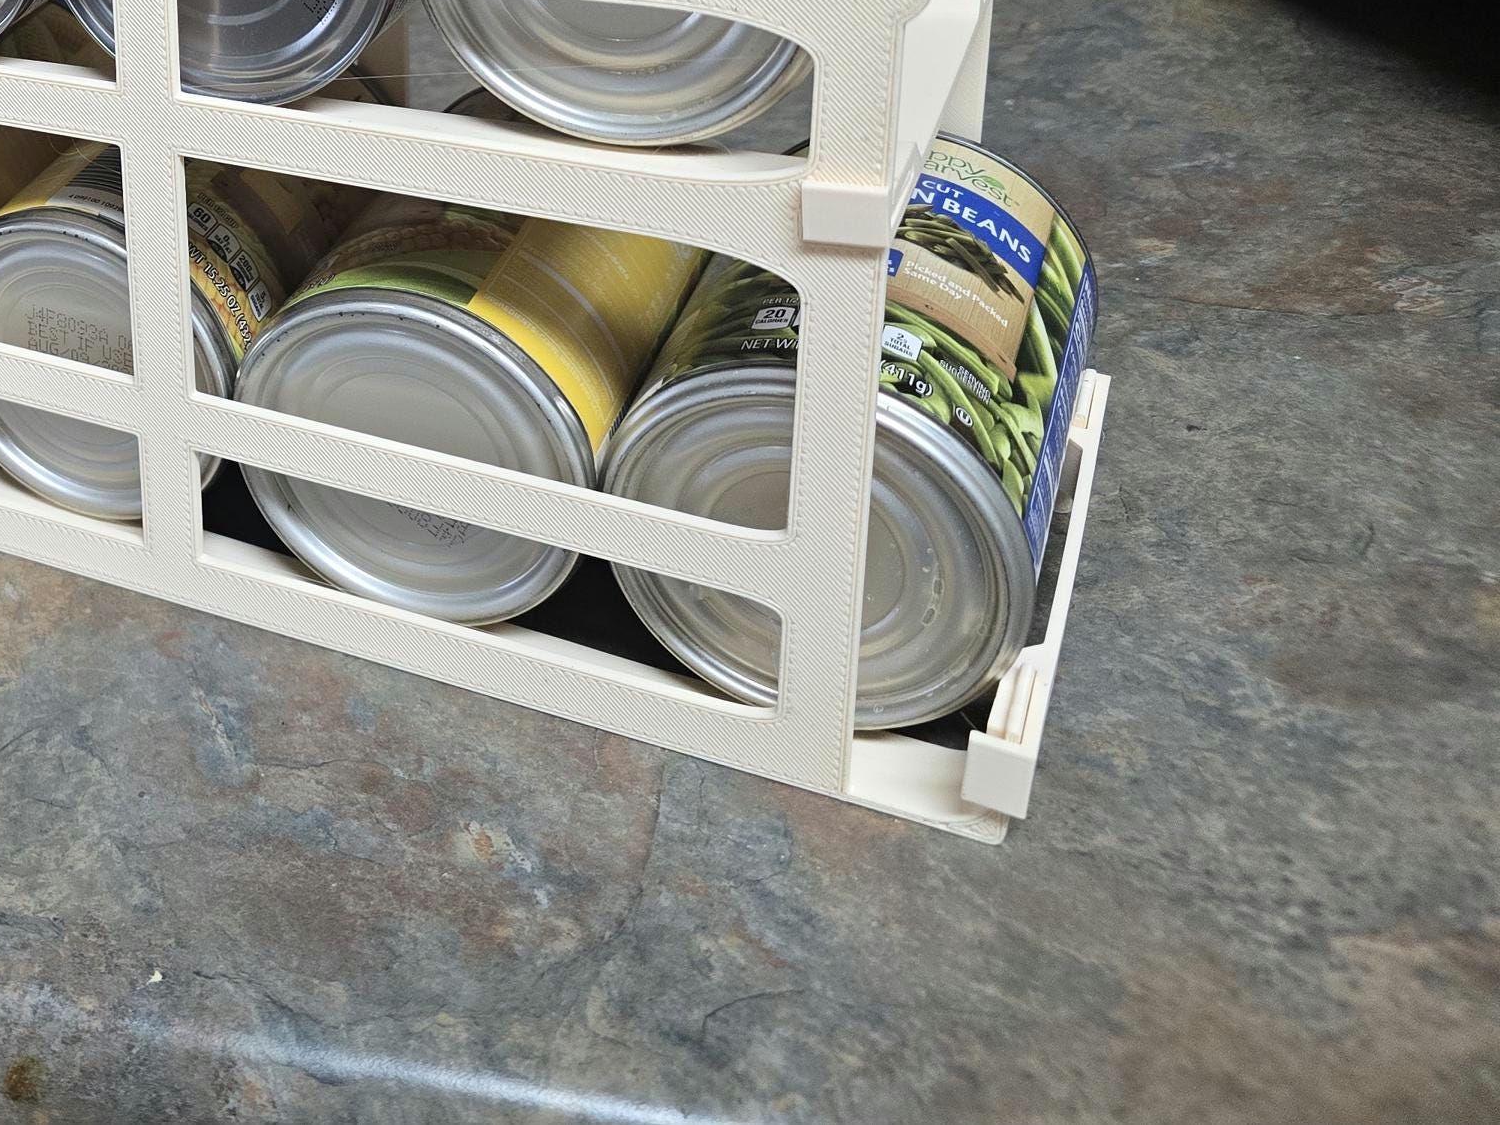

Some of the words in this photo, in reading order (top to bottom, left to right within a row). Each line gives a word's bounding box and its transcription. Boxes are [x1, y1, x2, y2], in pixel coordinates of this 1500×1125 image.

[928, 150, 987, 175] ppy
[922, 180, 964, 199] CUT
[924, 160, 1012, 208] arvest
[193, 207, 212, 224] 60
[942, 197, 1032, 264] BEANS
[203, 261, 231, 299] 15.25
[226, 294, 241, 317] OZ
[904, 267, 937, 287] Same
[939, 282, 962, 300] Day
[906, 260, 948, 285] Picked
[949, 279, 971, 297] and
[972, 291, 1009, 328] Packed
[763, 309, 786, 319] 20
[78, 336, 94, 353] IF
[102, 345, 133, 370] USE
[740, 339, 772, 351] NET
[890, 337, 912, 351] TOTAL
[880, 359, 934, 397] (411g)
[938, 359, 992, 405] SUGGESTION
[958, 365, 992, 398] SERVING
